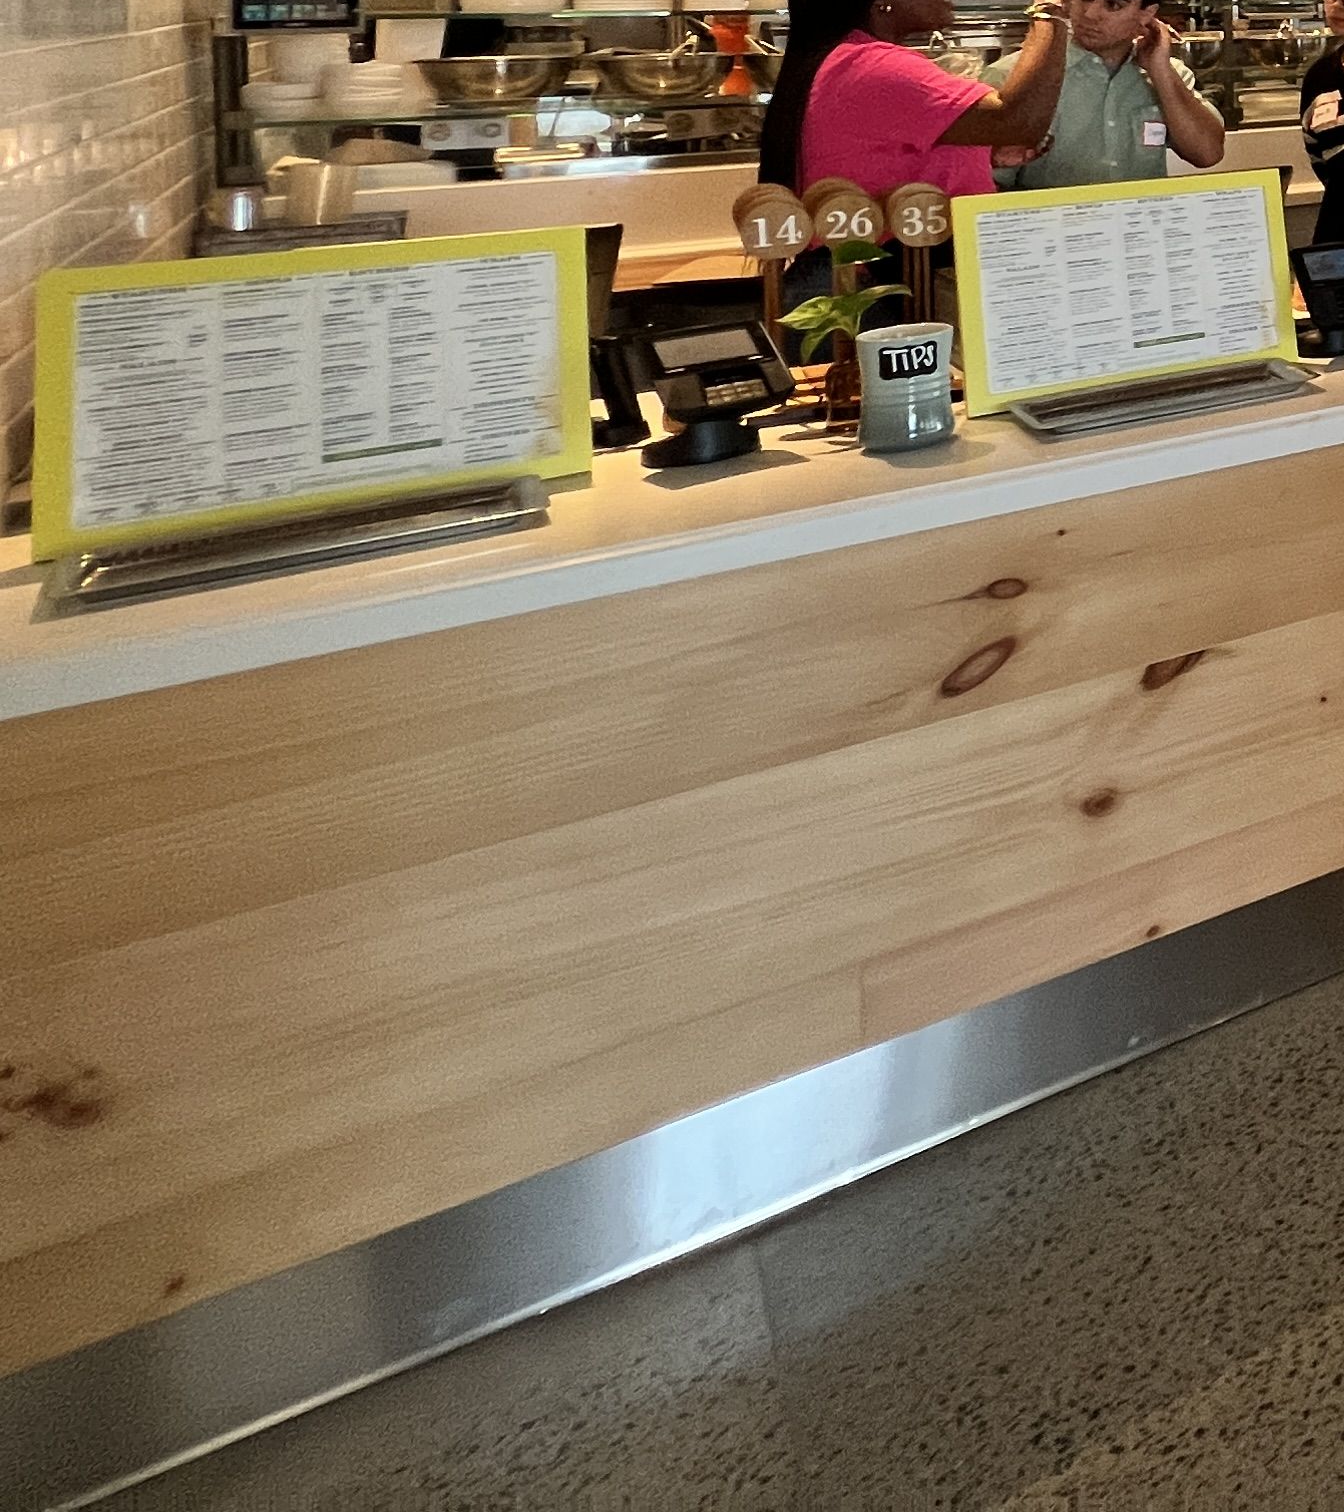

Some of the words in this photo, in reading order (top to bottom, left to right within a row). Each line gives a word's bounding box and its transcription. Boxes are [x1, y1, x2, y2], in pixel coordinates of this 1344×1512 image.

[750, 215, 802, 249] 14
[826, 208, 873, 239] 26
[902, 204, 948, 236] 35
[882, 345, 935, 373] TIPS
